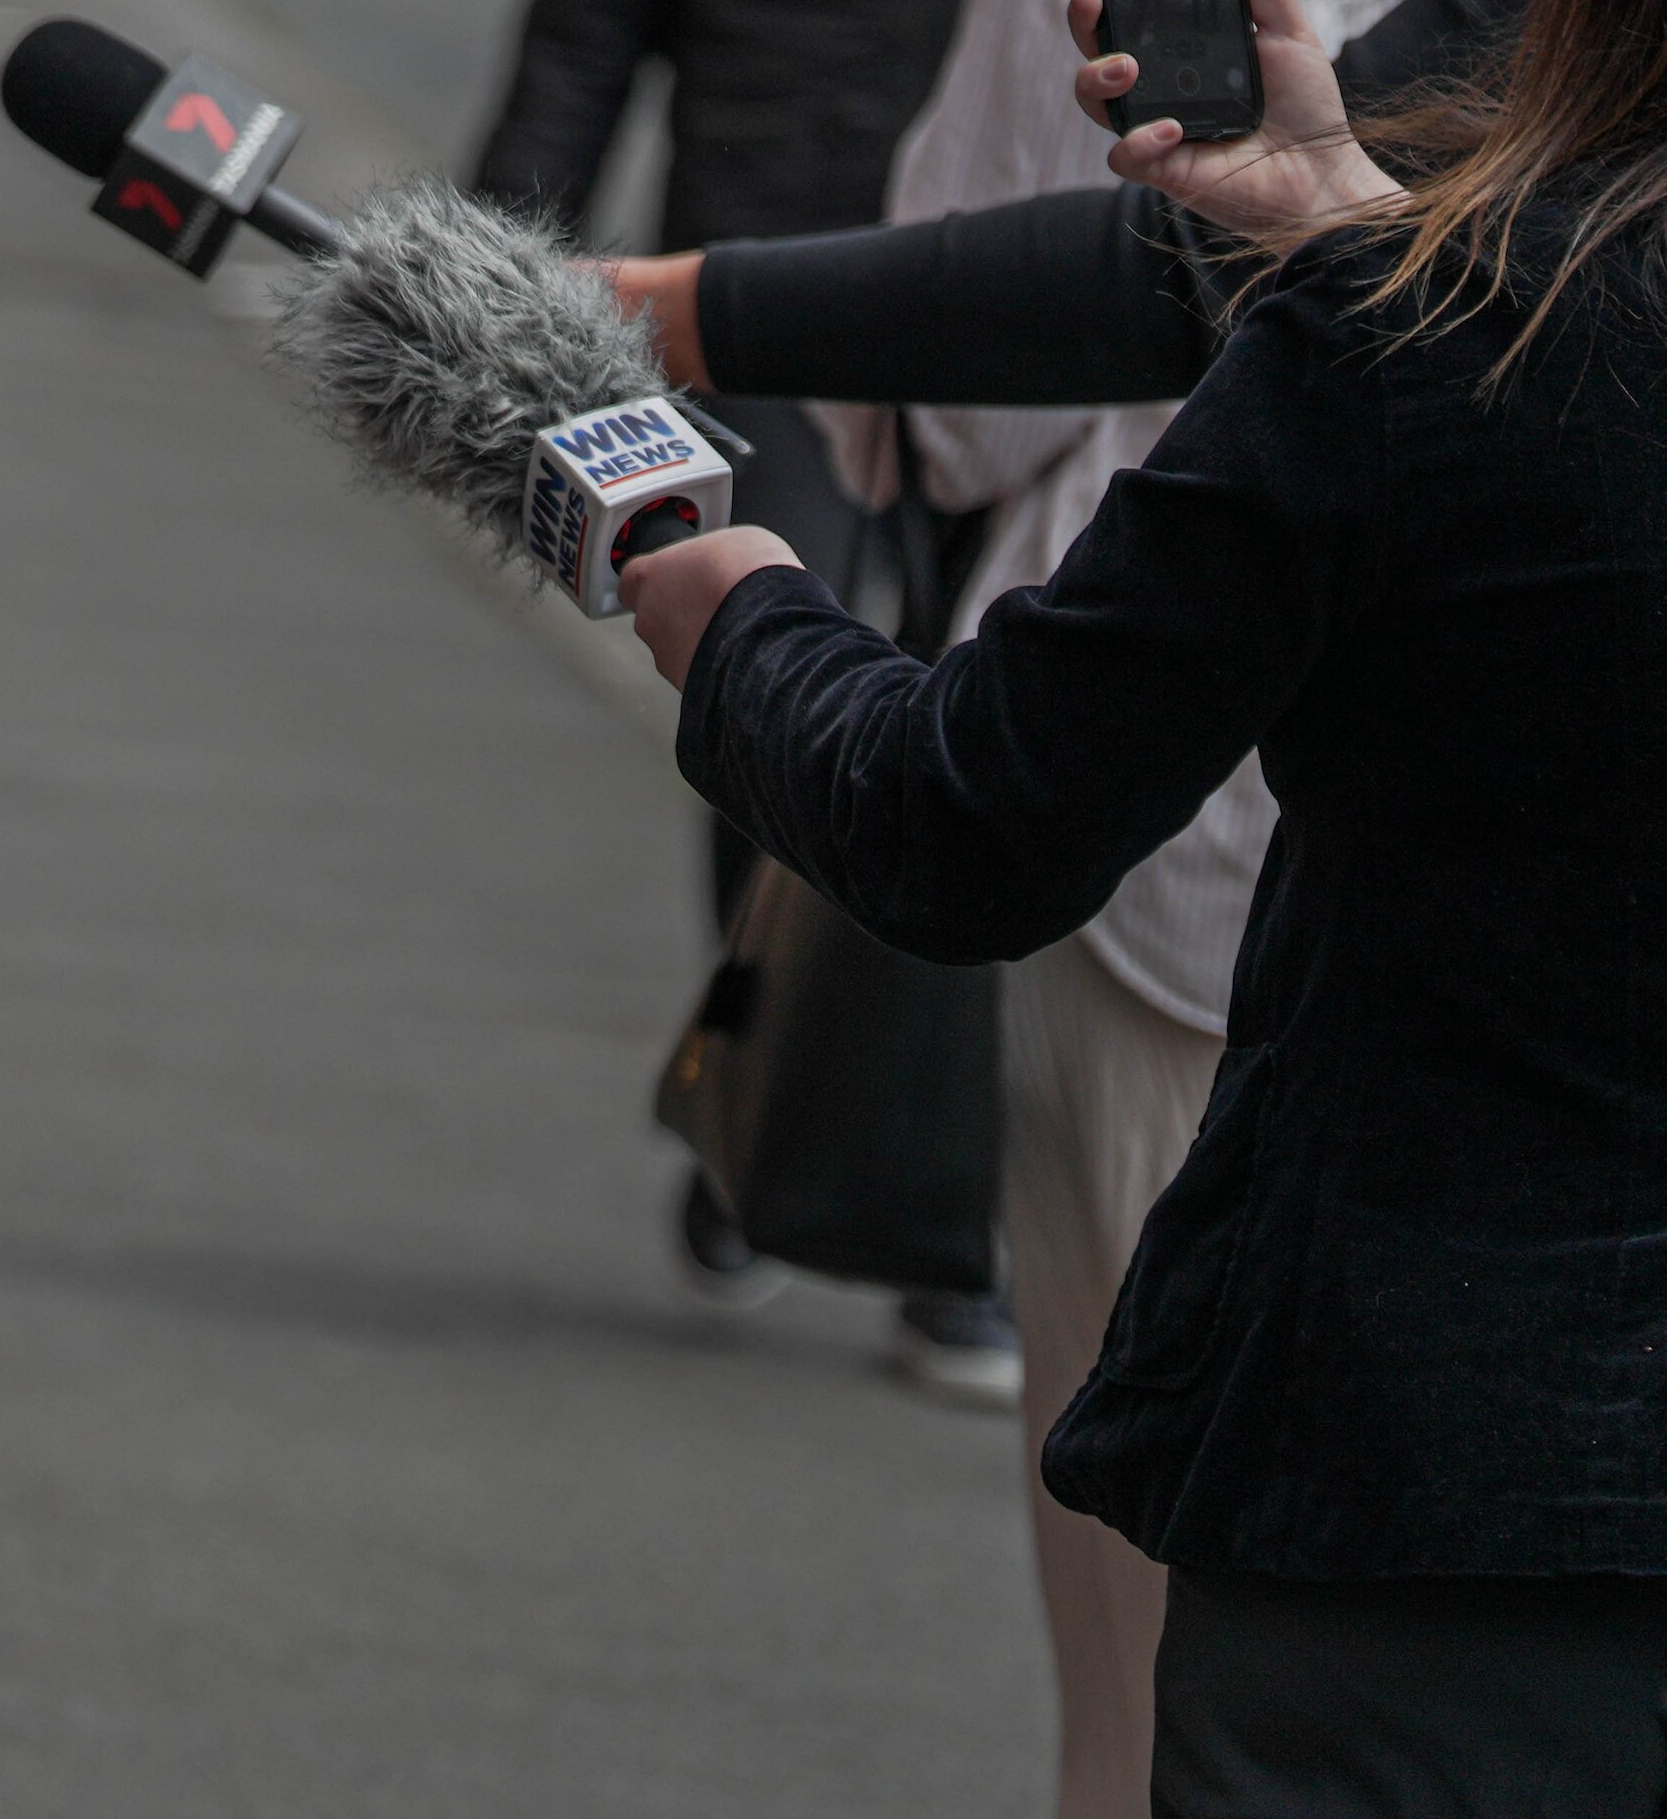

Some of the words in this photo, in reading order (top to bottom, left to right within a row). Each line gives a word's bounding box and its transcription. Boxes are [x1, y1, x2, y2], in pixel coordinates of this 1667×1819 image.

[165, 93, 237, 153] 7
[120, 179, 182, 232] 7
[553, 409, 676, 461] WIN
[584, 439, 695, 484] NEWS
[529, 456, 566, 566] WIN
[558, 487, 585, 590] NEWS
